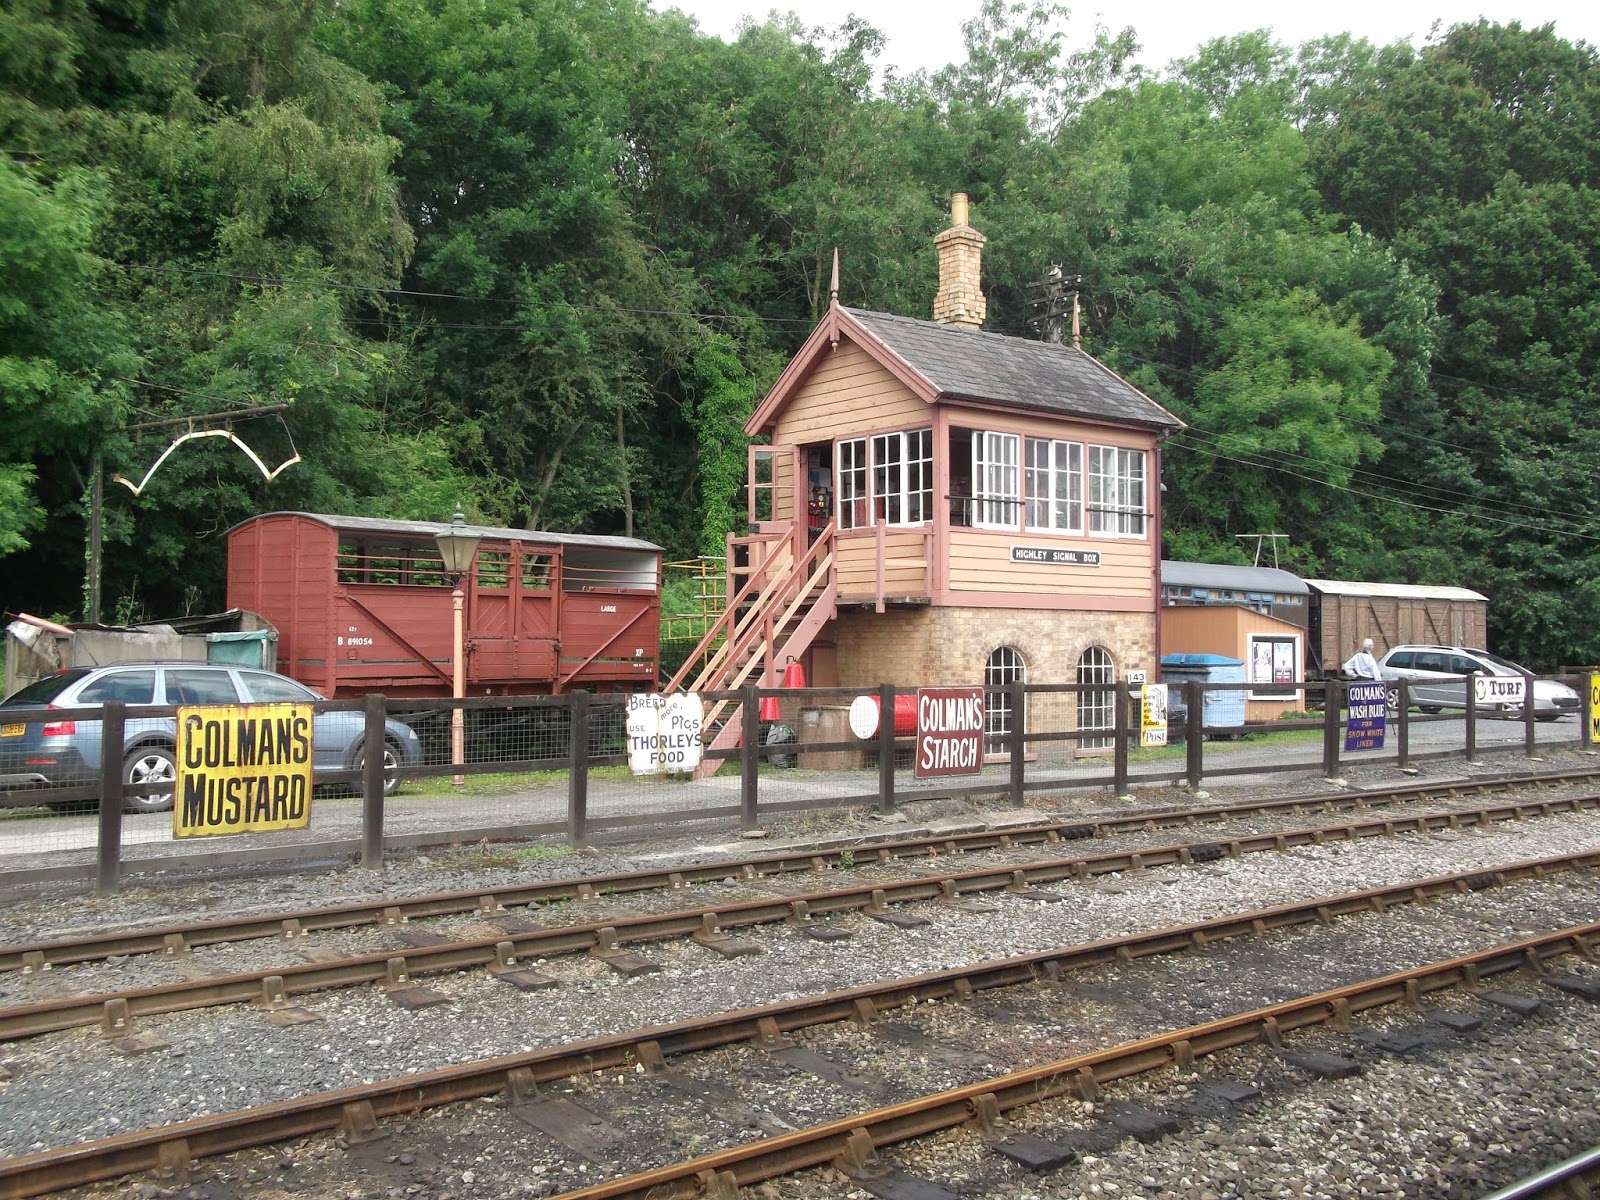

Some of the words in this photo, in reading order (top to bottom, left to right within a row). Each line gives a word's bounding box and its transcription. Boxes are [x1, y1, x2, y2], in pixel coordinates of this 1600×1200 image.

[1016, 550, 1048, 560] HIGHLEY
[1052, 552, 1078, 562] SIGNAL
[1083, 554, 1097, 562] BOX
[338, 636, 344, 646] B
[348, 638, 372, 646] 891054
[636, 648, 644, 656] XP
[1350, 685, 1385, 701] COLMAN'S
[1489, 681, 1522, 696] TURF
[630, 696, 666, 711] BREED
[920, 692, 983, 732] COLMAN'S
[1350, 706, 1368, 719] WASH
[1368, 704, 1384, 718] BLUE
[185, 710, 308, 769] COLMAN'S
[1348, 730, 1366, 738] SNOW
[650, 751, 684, 764] FOOD
[921, 736, 978, 769] STARCH
[182, 773, 306, 828] MUSTARD
